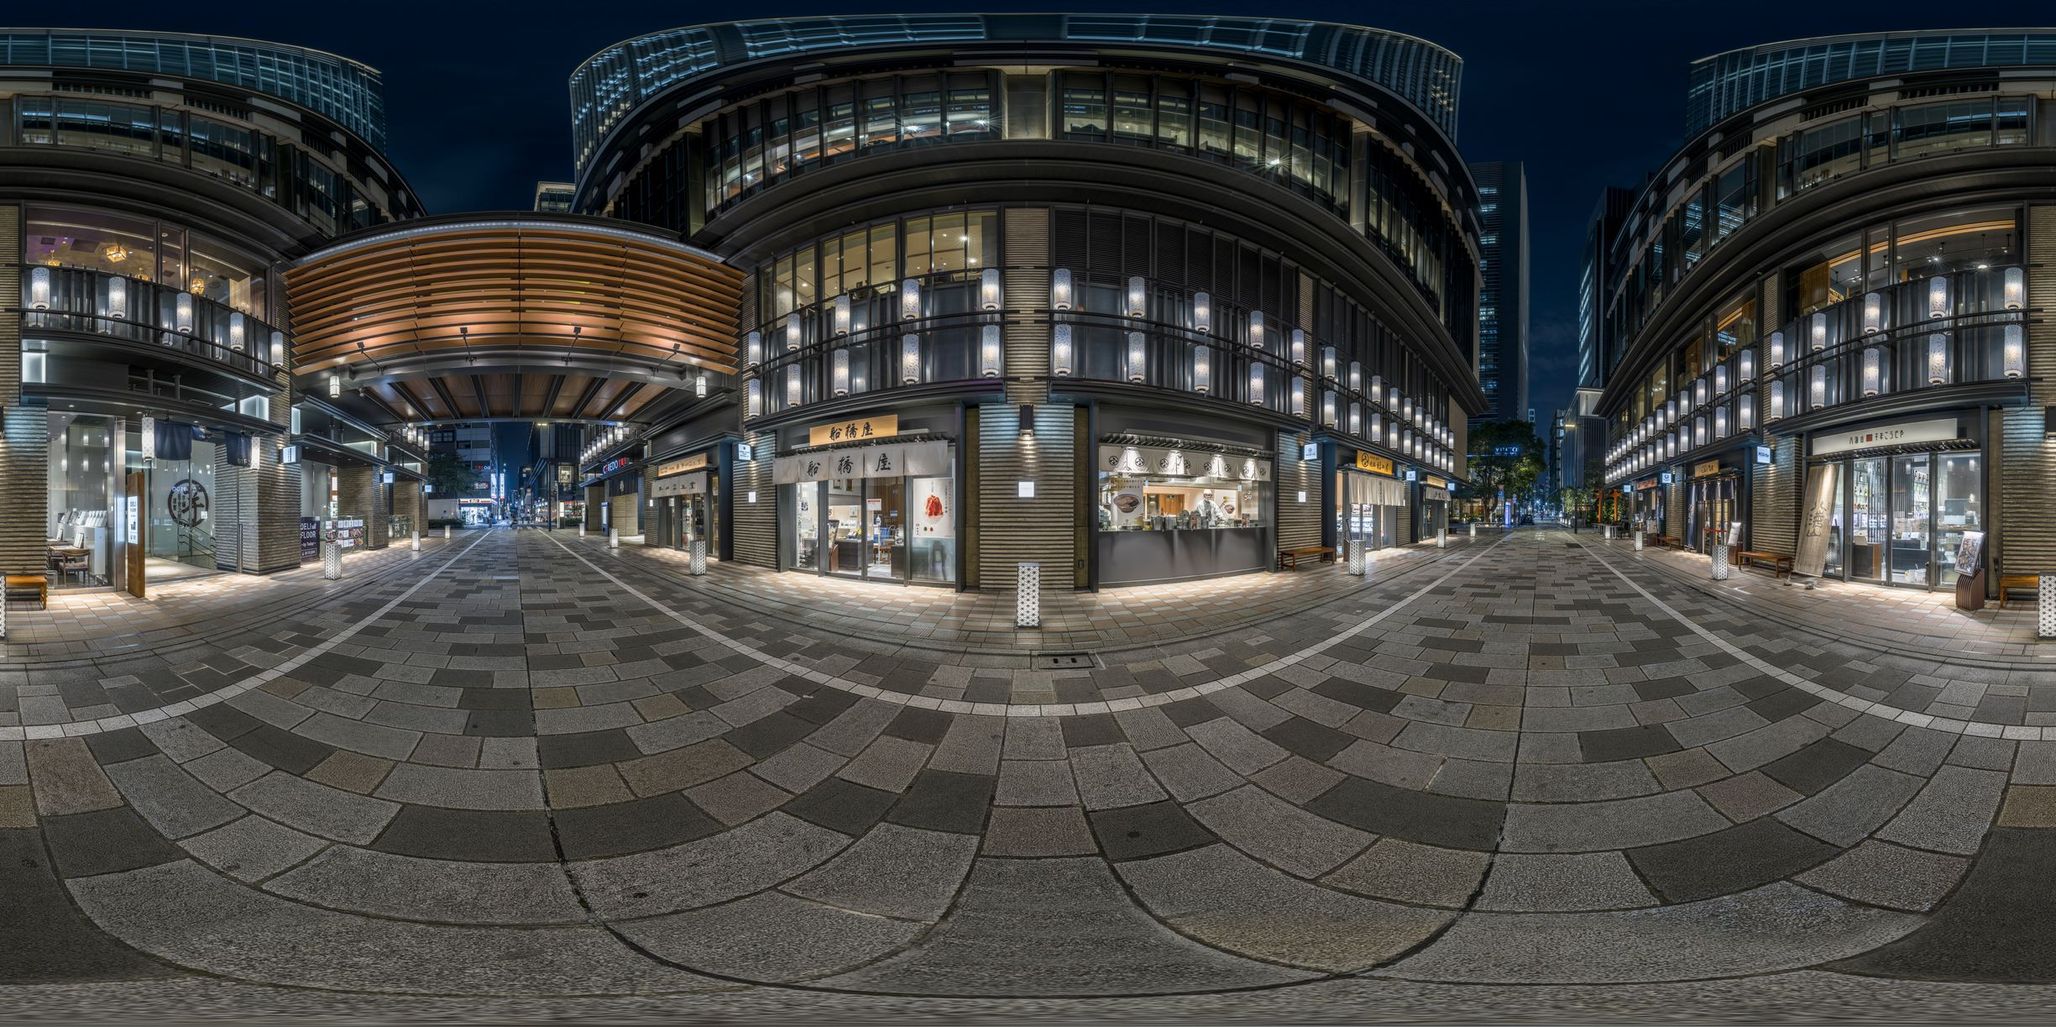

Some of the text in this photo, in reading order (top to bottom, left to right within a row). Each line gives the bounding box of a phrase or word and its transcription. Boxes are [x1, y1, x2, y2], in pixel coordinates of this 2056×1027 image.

[829, 421, 873, 441] 船橋屋
[807, 453, 891, 477] 船橋屋
